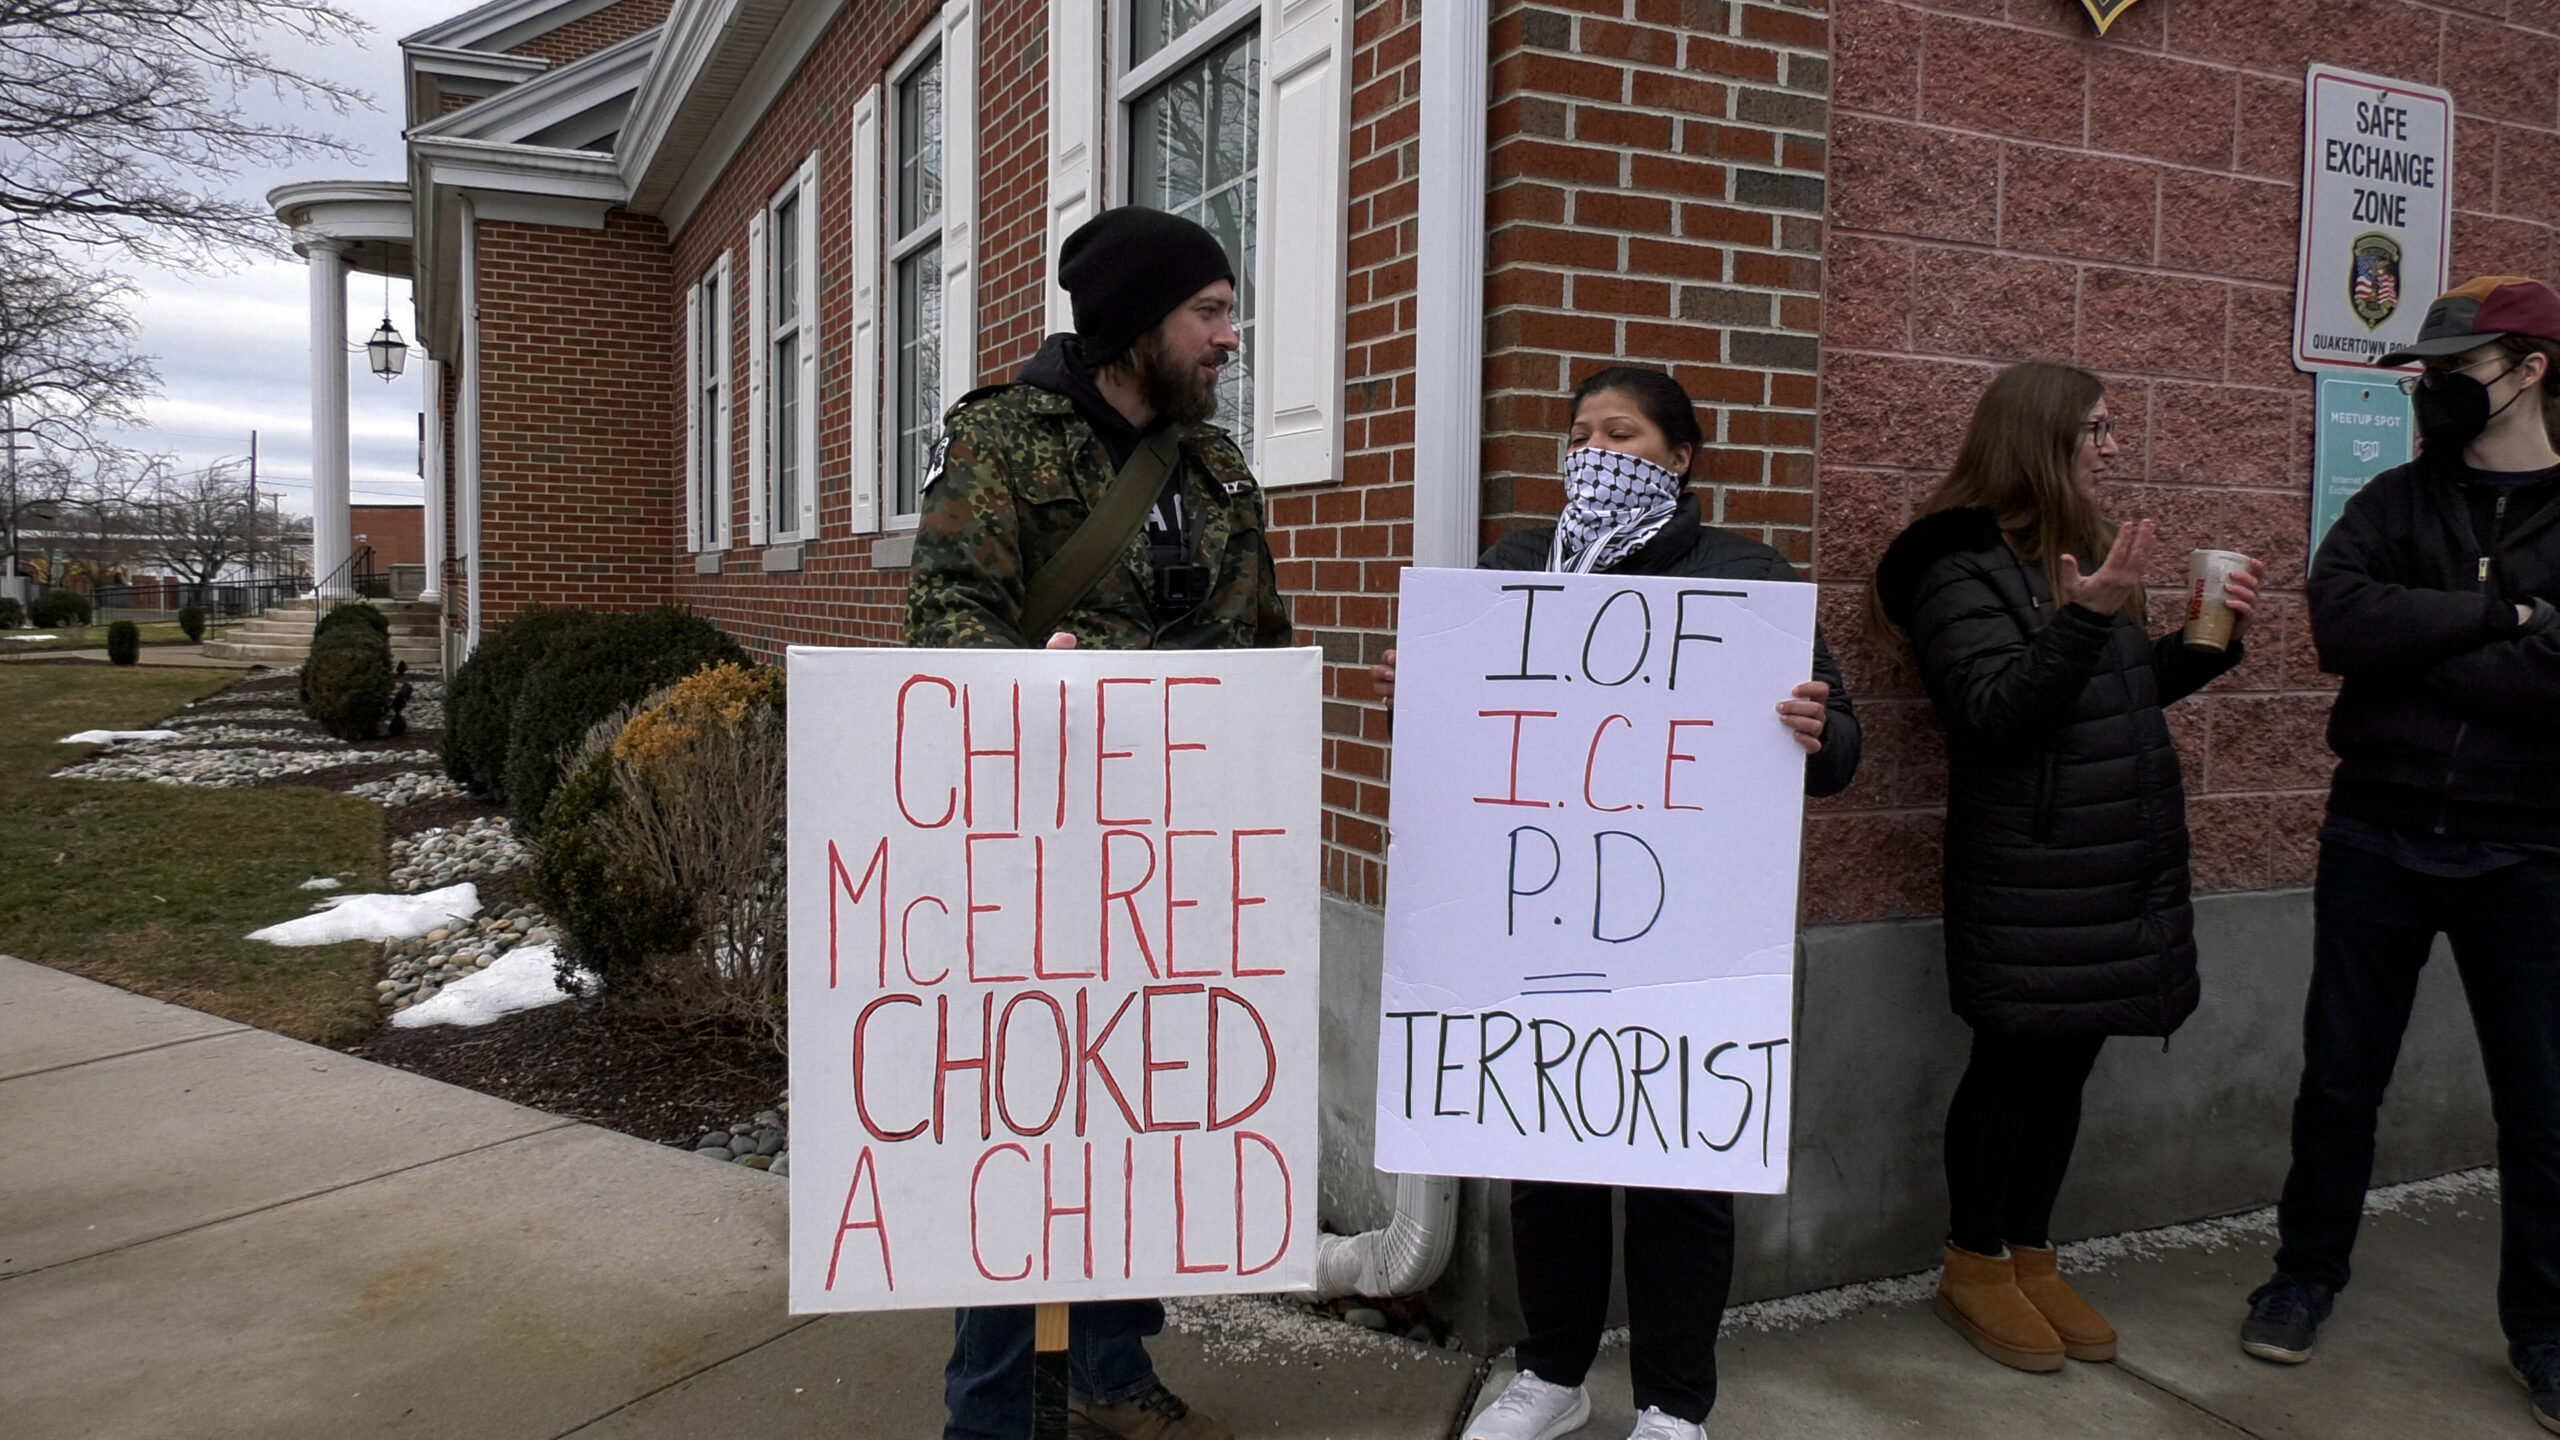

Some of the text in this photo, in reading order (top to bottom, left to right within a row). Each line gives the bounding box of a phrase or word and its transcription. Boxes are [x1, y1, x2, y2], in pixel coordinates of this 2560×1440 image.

[2325, 138, 2434, 189] EXCHANGE
[2356, 101, 2408, 142] SAFE
[2352, 188, 2407, 228] ZONE
[2312, 334, 2386, 355] QUAKERTOWN
[2330, 411, 2401, 428] MEETUP SPOT
[1485, 584, 1748, 691] I.O.F
[894, 674, 1222, 830] CHIEF
[1473, 710, 1714, 812] I.C.E
[1507, 825, 1665, 944] P.D
[852, 983, 1277, 1144] CHOKED
[1385, 1010, 1790, 1168] TERRORIST
[825, 1130, 1292, 1292] A CHILD
